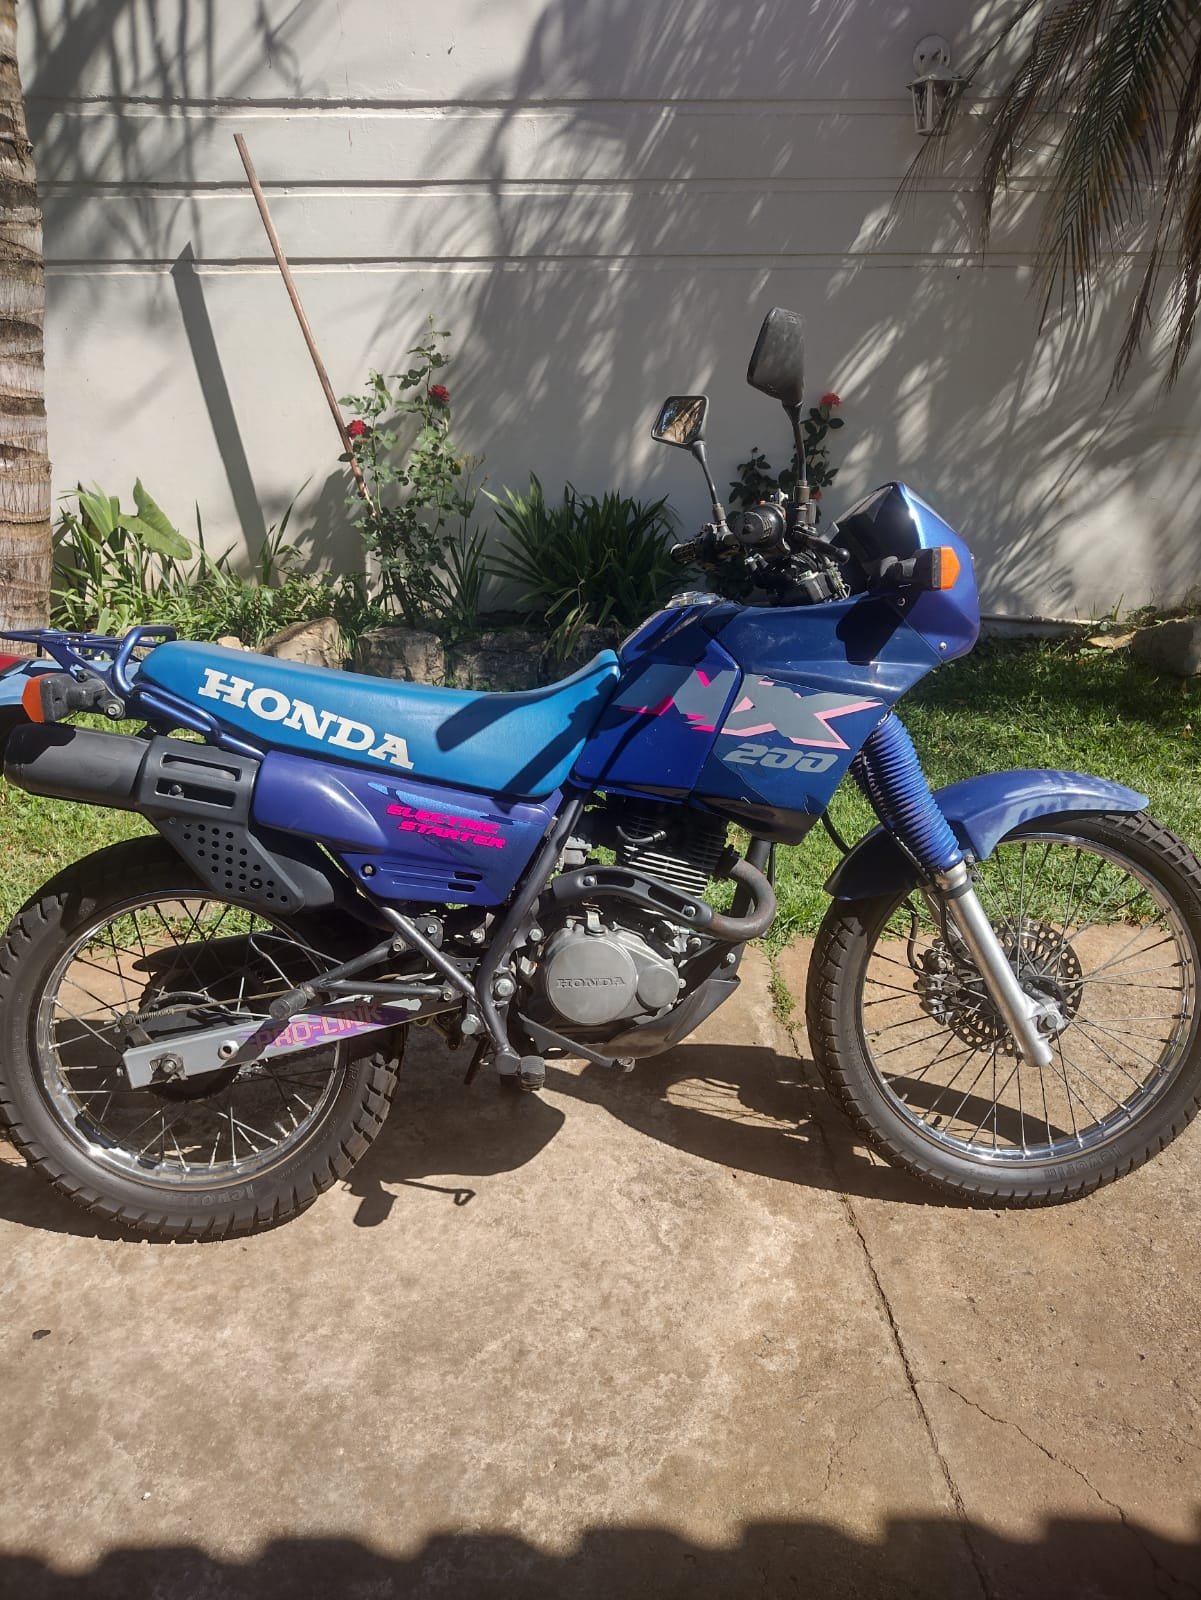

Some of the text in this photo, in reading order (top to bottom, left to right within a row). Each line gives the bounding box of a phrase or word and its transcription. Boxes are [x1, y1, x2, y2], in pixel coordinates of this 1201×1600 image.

[198, 668, 414, 769] HONDA
[723, 743, 838, 772] 200
[386, 803, 501, 834] ELECTRIC
[398, 820, 506, 848] STARTER
[556, 976, 626, 988] HONDA
[255, 1002, 382, 1050] PRO-LINK
